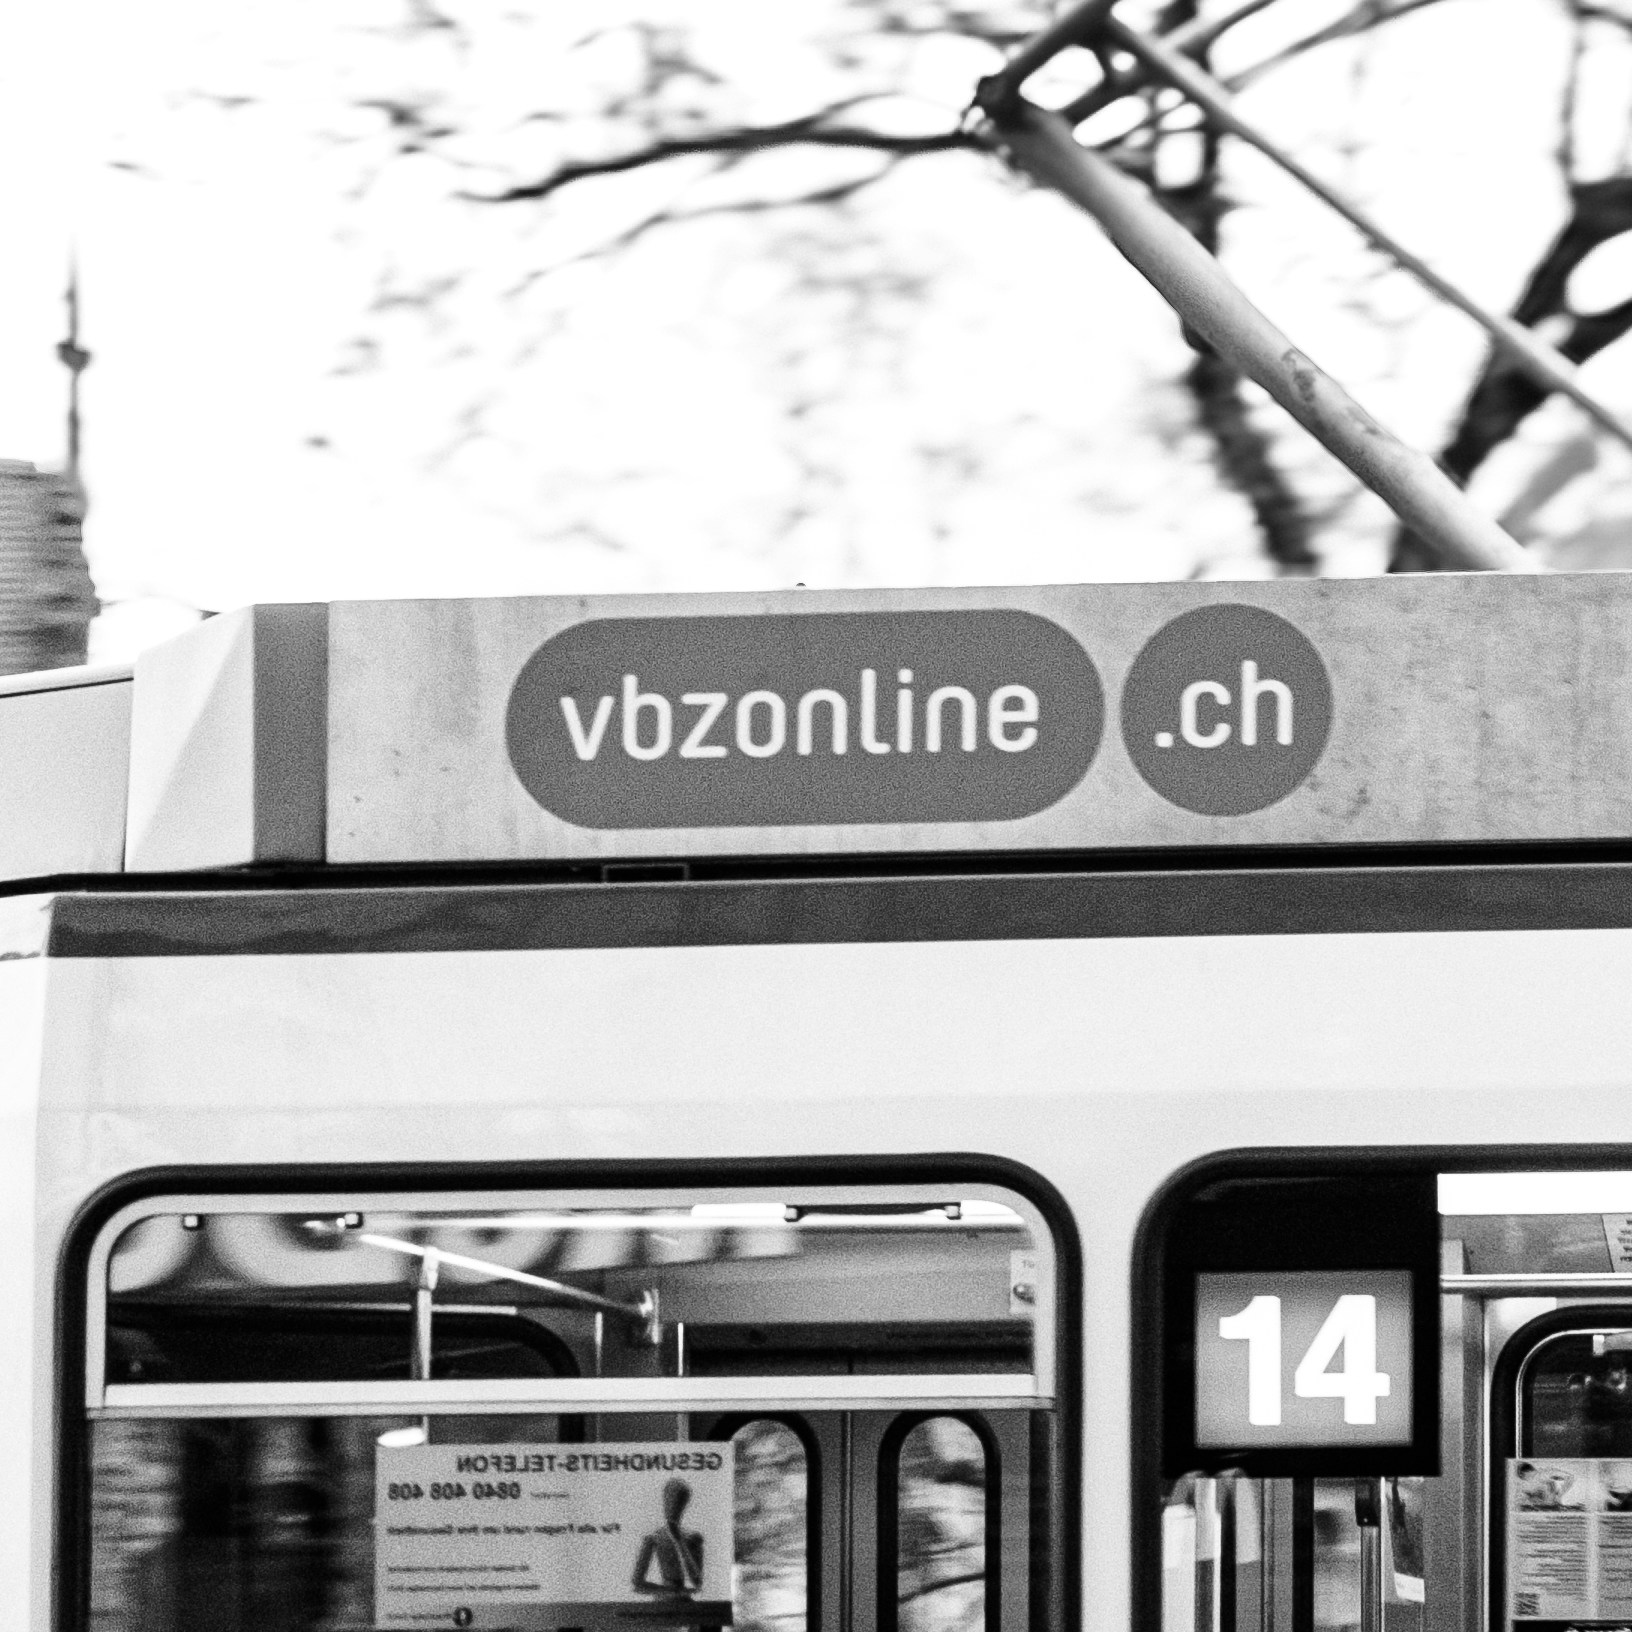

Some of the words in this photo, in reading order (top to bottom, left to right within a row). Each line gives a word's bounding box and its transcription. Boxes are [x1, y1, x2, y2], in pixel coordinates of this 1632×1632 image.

[560, 667, 1039, 761] vbzonline
[1154, 659, 1294, 749] .ch
[1219, 1295, 1390, 1426] 14
